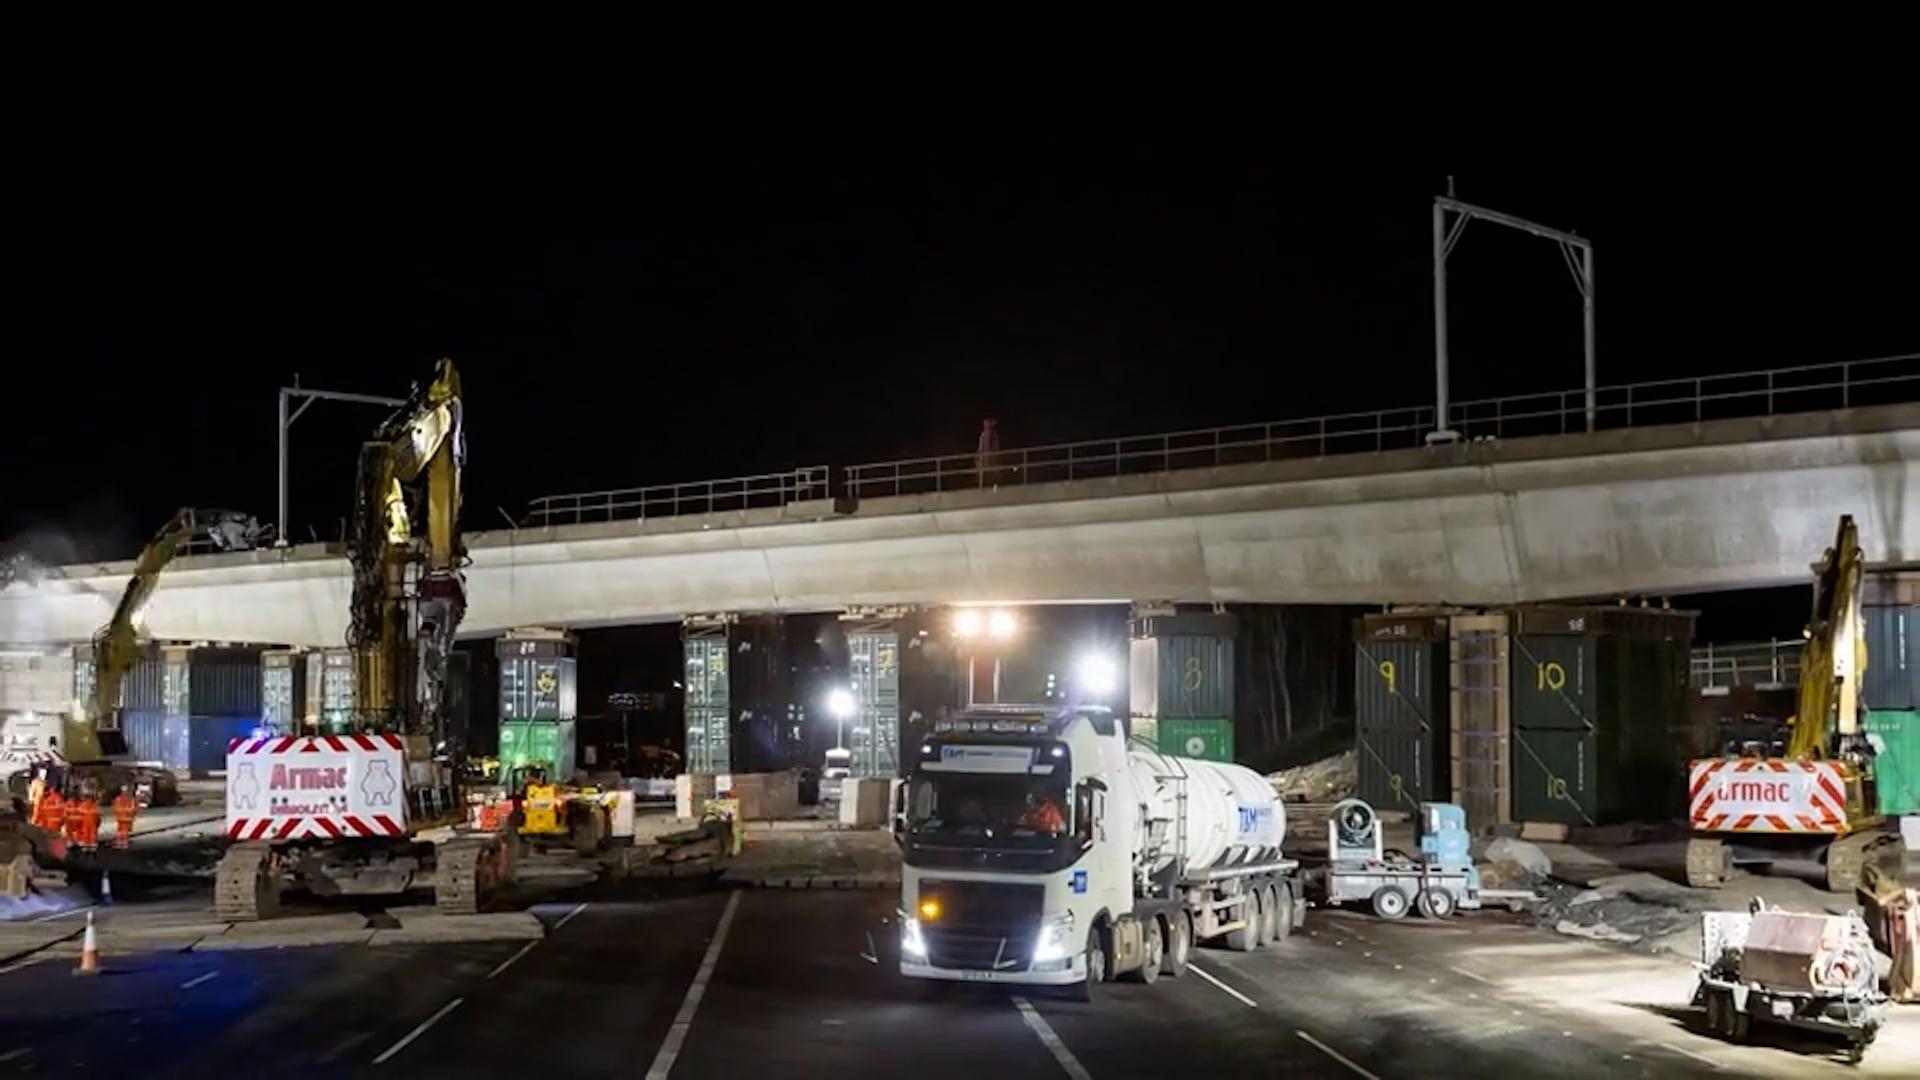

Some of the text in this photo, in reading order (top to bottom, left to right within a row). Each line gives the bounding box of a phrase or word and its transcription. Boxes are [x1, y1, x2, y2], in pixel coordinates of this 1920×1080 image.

[1379, 660, 1396, 692] 9
[1537, 661, 1566, 691] 10
[270, 764, 347, 790] Armac
